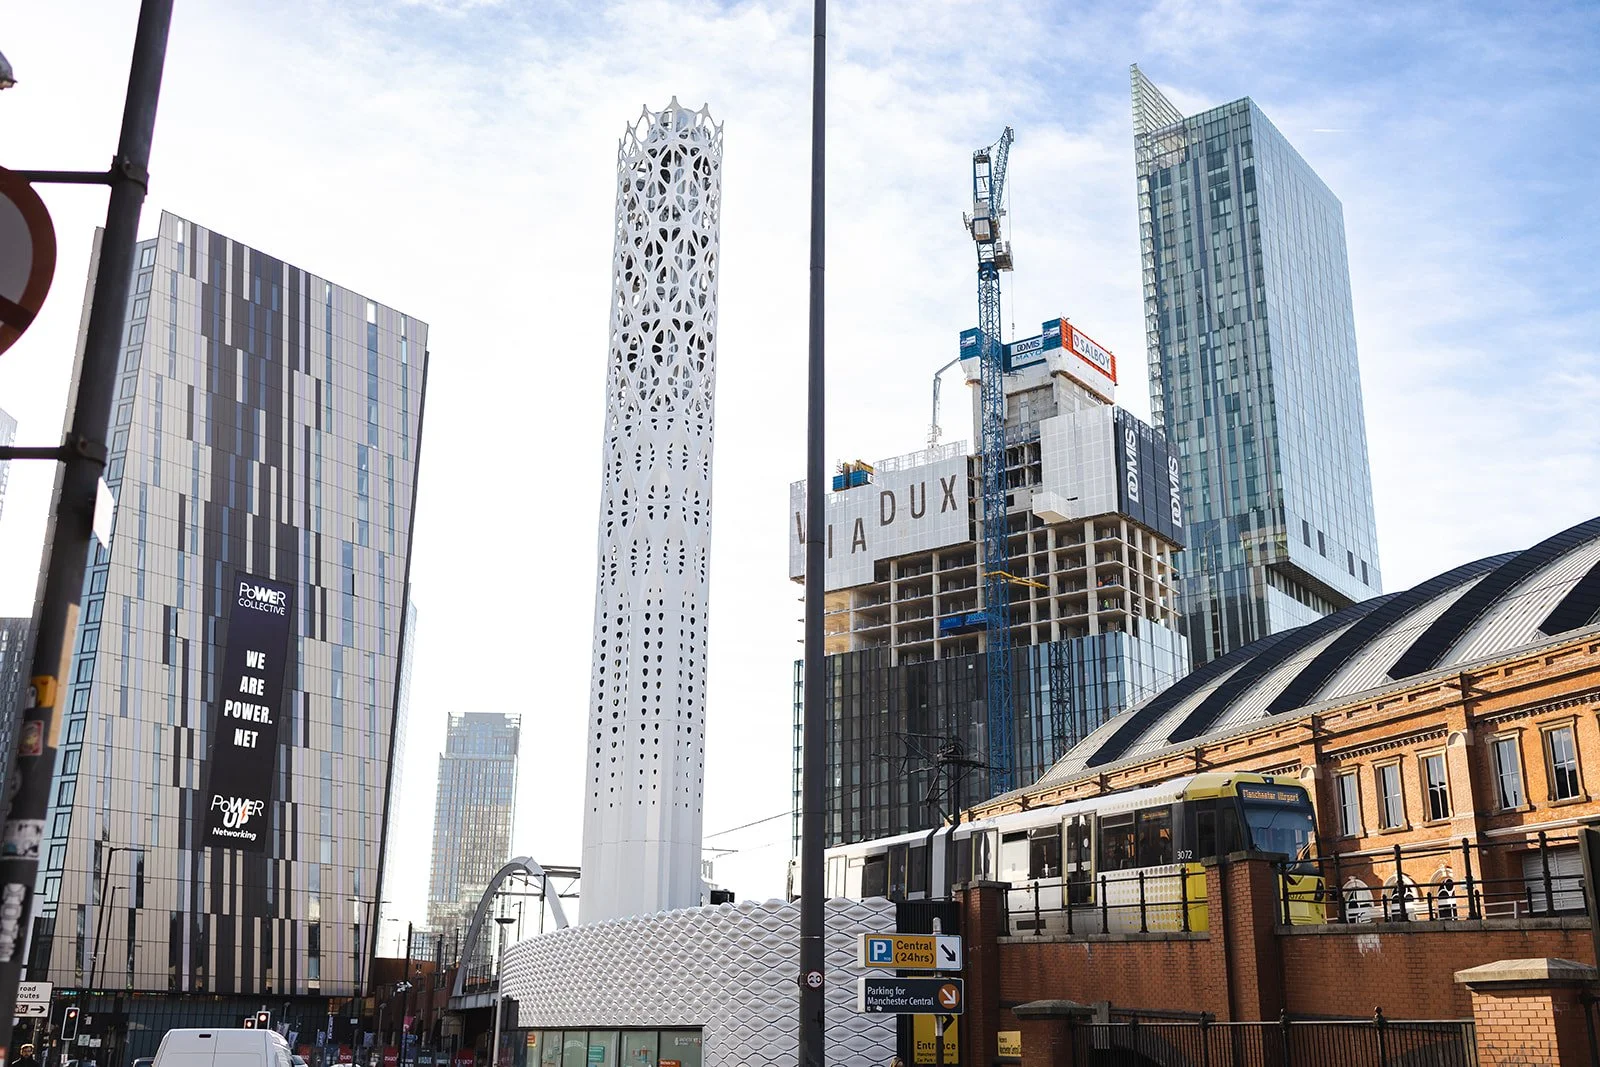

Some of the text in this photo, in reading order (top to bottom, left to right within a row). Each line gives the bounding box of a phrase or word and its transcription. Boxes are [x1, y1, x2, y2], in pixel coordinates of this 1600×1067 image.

[1016, 339, 1040, 352] DOMIS
[1080, 338, 1110, 369] SALBOY
[1125, 428, 1139, 503] DOMIS
[1168, 455, 1182, 527] DOMIS
[238, 598, 286, 616] COLLECTIVE
[246, 650, 266, 670] WE
[239, 675, 265, 696] ARE
[223, 699, 273, 724] POWER.
[233, 728, 259, 748] NET
[212, 827, 258, 841] Networking
[1177, 850, 1193, 860] 3072
[873, 941, 887, 961] P
[896, 940, 933, 951] Central
[895, 952, 934, 965] (24hrs)
[867, 986, 906, 997] Parking for
[867, 996, 935, 1006] Manchester Central
[916, 1040, 957, 1050] Entrce
